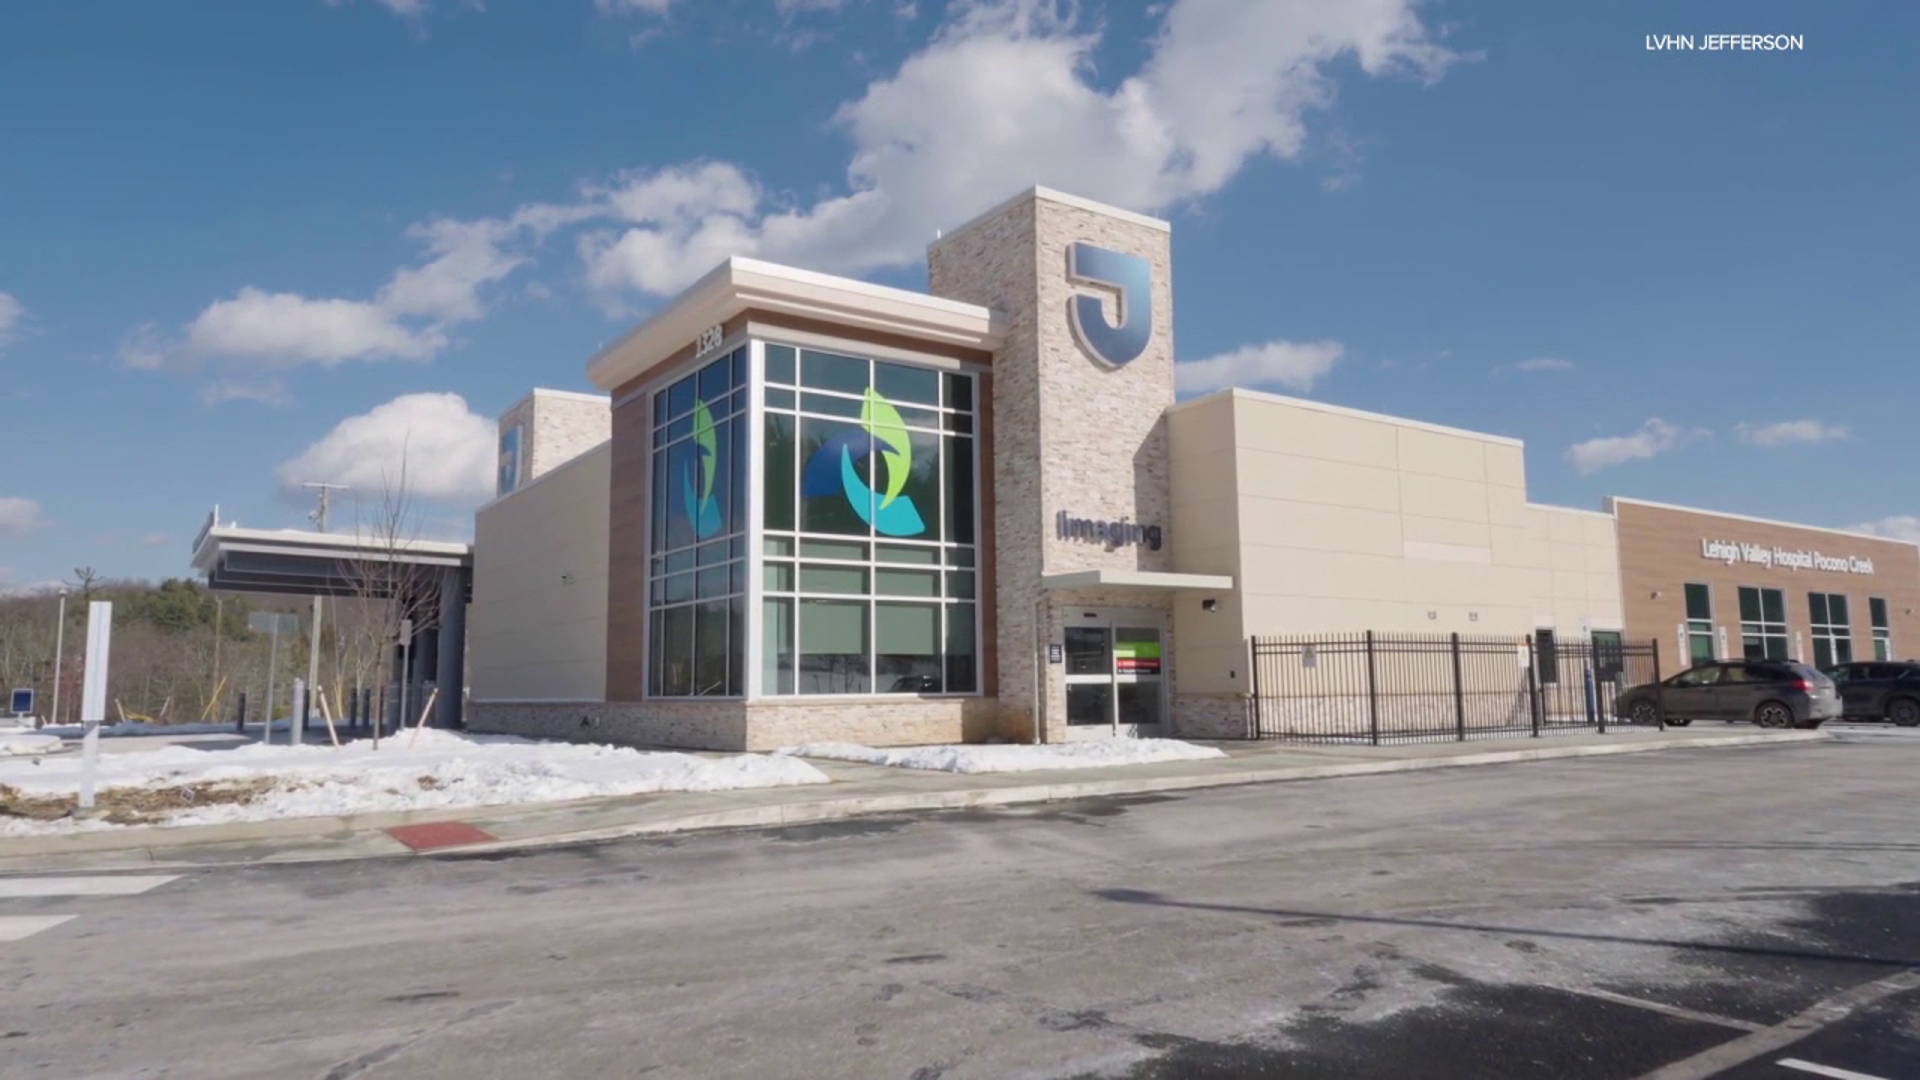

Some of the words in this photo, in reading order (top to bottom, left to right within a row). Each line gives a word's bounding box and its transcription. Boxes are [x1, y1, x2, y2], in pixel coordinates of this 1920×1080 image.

[1059, 510, 1161, 551] Imaging
[1702, 538, 1740, 565] Lehigh
[1740, 542, 1771, 569] Valley
[1773, 546, 1813, 571] Hospital
[1814, 551, 1848, 572] Pocono
[1849, 556, 1874, 574] Creek
